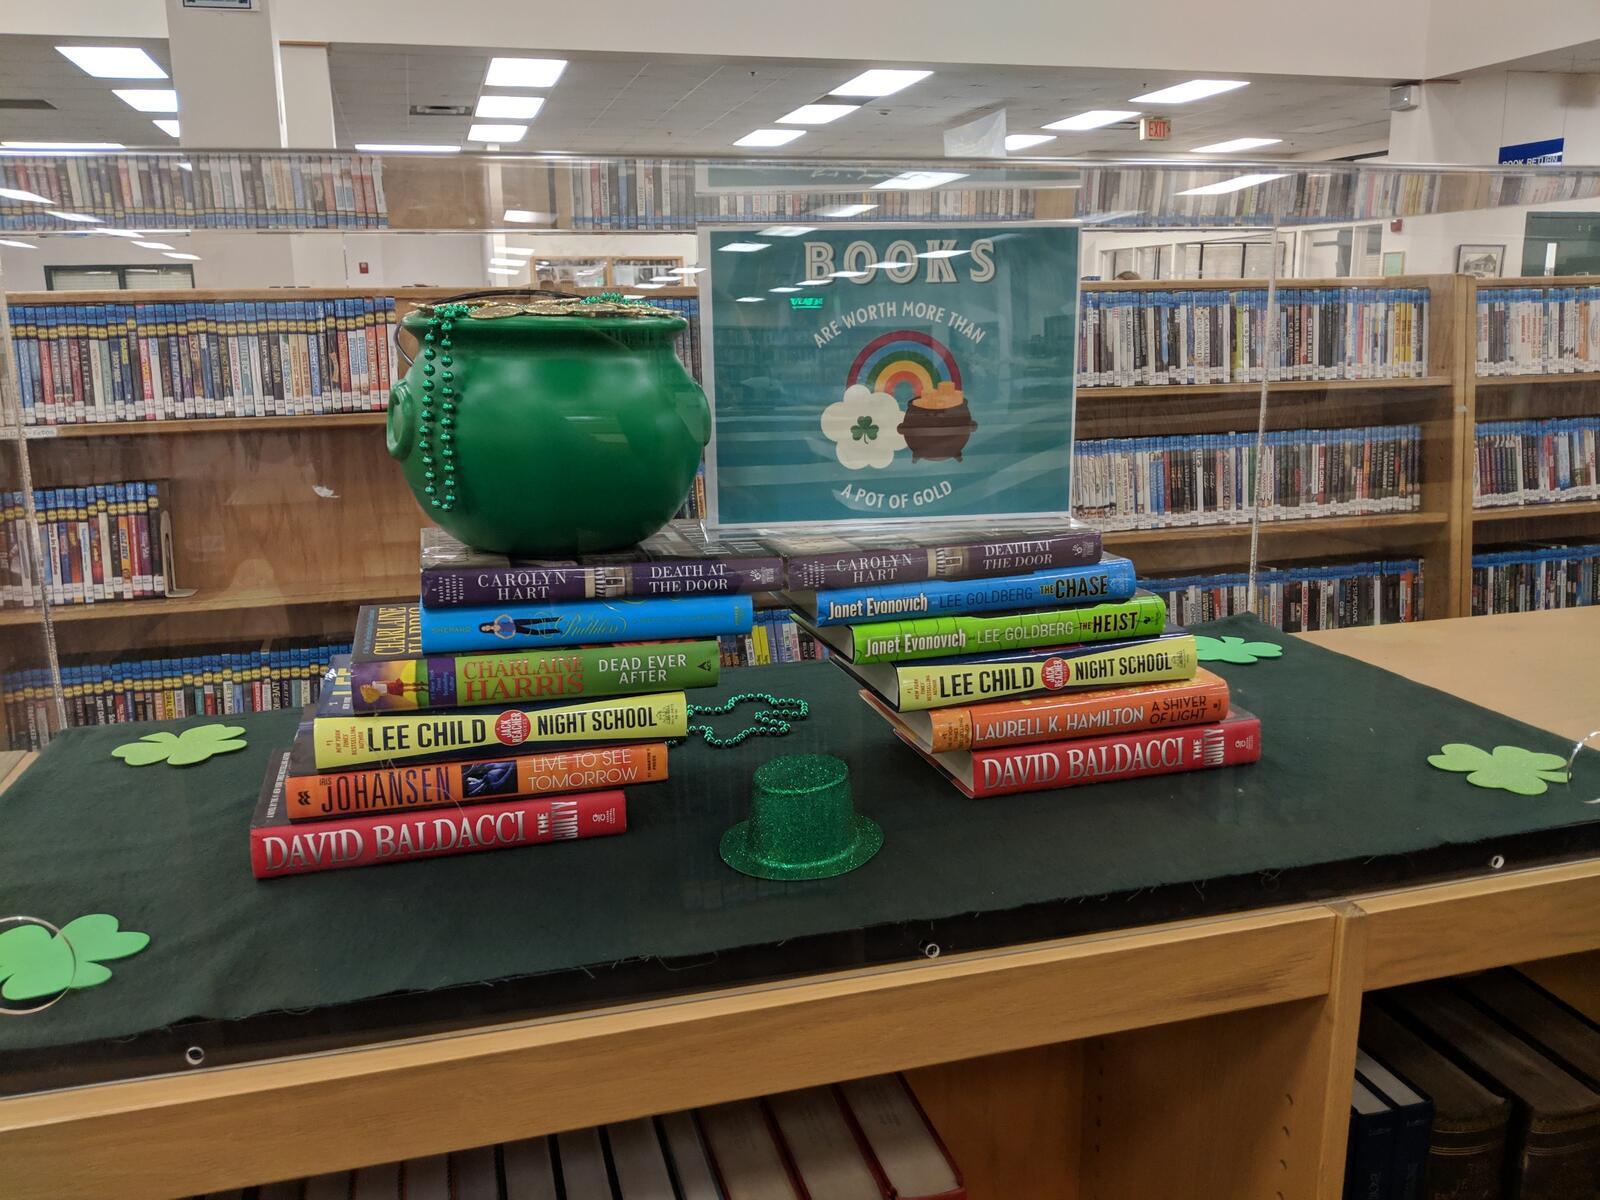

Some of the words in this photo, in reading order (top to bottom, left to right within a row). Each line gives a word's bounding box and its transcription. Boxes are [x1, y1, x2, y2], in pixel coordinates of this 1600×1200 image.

[1149, 121, 1168, 137] EXIT
[804, 238, 996, 284] BOOKS
[813, 320, 842, 349] ARE
[842, 301, 897, 329] WORTH
[902, 301, 945, 323] MORE
[950, 311, 986, 344] THAN
[841, 483, 853, 498] A
[855, 488, 885, 508] POT
[889, 493, 908, 509] OF
[913, 480, 952, 507] GOLD
[984, 541, 1029, 557] DEATH
[1033, 540, 1051, 552] AT
[650, 565, 703, 579] DEATH
[707, 563, 727, 577] AT
[836, 553, 912, 572] CAROLYN
[982, 556, 1012, 570] THE
[1014, 554, 1053, 568] DOOR
[477, 571, 566, 588] CAROLYN
[649, 580, 681, 593] THE
[686, 578, 728, 592] DOOR
[853, 567, 898, 584] HART
[1039, 585, 1055, 595] THE
[1055, 575, 1108, 599] CHASE
[497, 586, 550, 601] HART
[939, 594, 961, 609] LEE
[966, 587, 1033, 606] GOLDBERG
[828, 601, 863, 620] Janet
[866, 593, 928, 617] Evanovich
[373, 607, 406, 656] CHARLAINE
[976, 628, 1001, 644] LEE
[1004, 621, 1074, 641] GOLDBERG
[1079, 622, 1092, 630] THE
[1092, 611, 1138, 633] HEIST
[865, 638, 901, 657] Janet
[904, 628, 966, 653] Evanovich
[464, 655, 584, 680] CHARLAINE
[599, 657, 641, 672] DEAD
[648, 654, 687, 669] EVER
[1045, 665, 1054, 683] JACK
[1053, 660, 1063, 688] REACHER
[1075, 659, 1115, 681] NIGHT
[1119, 652, 1172, 677] SCHOOL
[464, 673, 584, 703] HARRIS
[619, 670, 667, 685] AFTER
[939, 672, 974, 698] LEE
[979, 666, 1034, 693] CHILD
[1152, 701, 1160, 712] A
[1163, 694, 1207, 710] SHIVER
[500, 719, 512, 737] JACK
[511, 712, 522, 743] REACHER
[537, 712, 587, 736] NIGHT
[591, 707, 657, 732] SCHOOL
[975, 717, 1044, 741] LAURELL
[1048, 715, 1062, 733] K.
[1066, 705, 1144, 731] HAMILTON
[1150, 713, 1167, 725] OF
[1169, 707, 1208, 722] LIGHT
[367, 725, 410, 752] LEE
[417, 719, 486, 748] CHILD
[1204, 728, 1224, 766] GUILTY
[533, 755, 568, 773] LIVE
[574, 752, 597, 769] TO
[602, 748, 632, 766] SEE
[1193, 738, 1202, 760] THE
[982, 752, 1060, 790] DAVID
[1067, 737, 1184, 779] BALDACCI
[319, 778, 332, 786] IRIS
[321, 766, 450, 813] JOHANSEN
[528, 766, 638, 792] TOMORROW
[537, 812, 549, 836] THE
[551, 801, 578, 840] GUILTY
[263, 828, 364, 870] DAVID
[372, 810, 526, 859] BALDACCI
